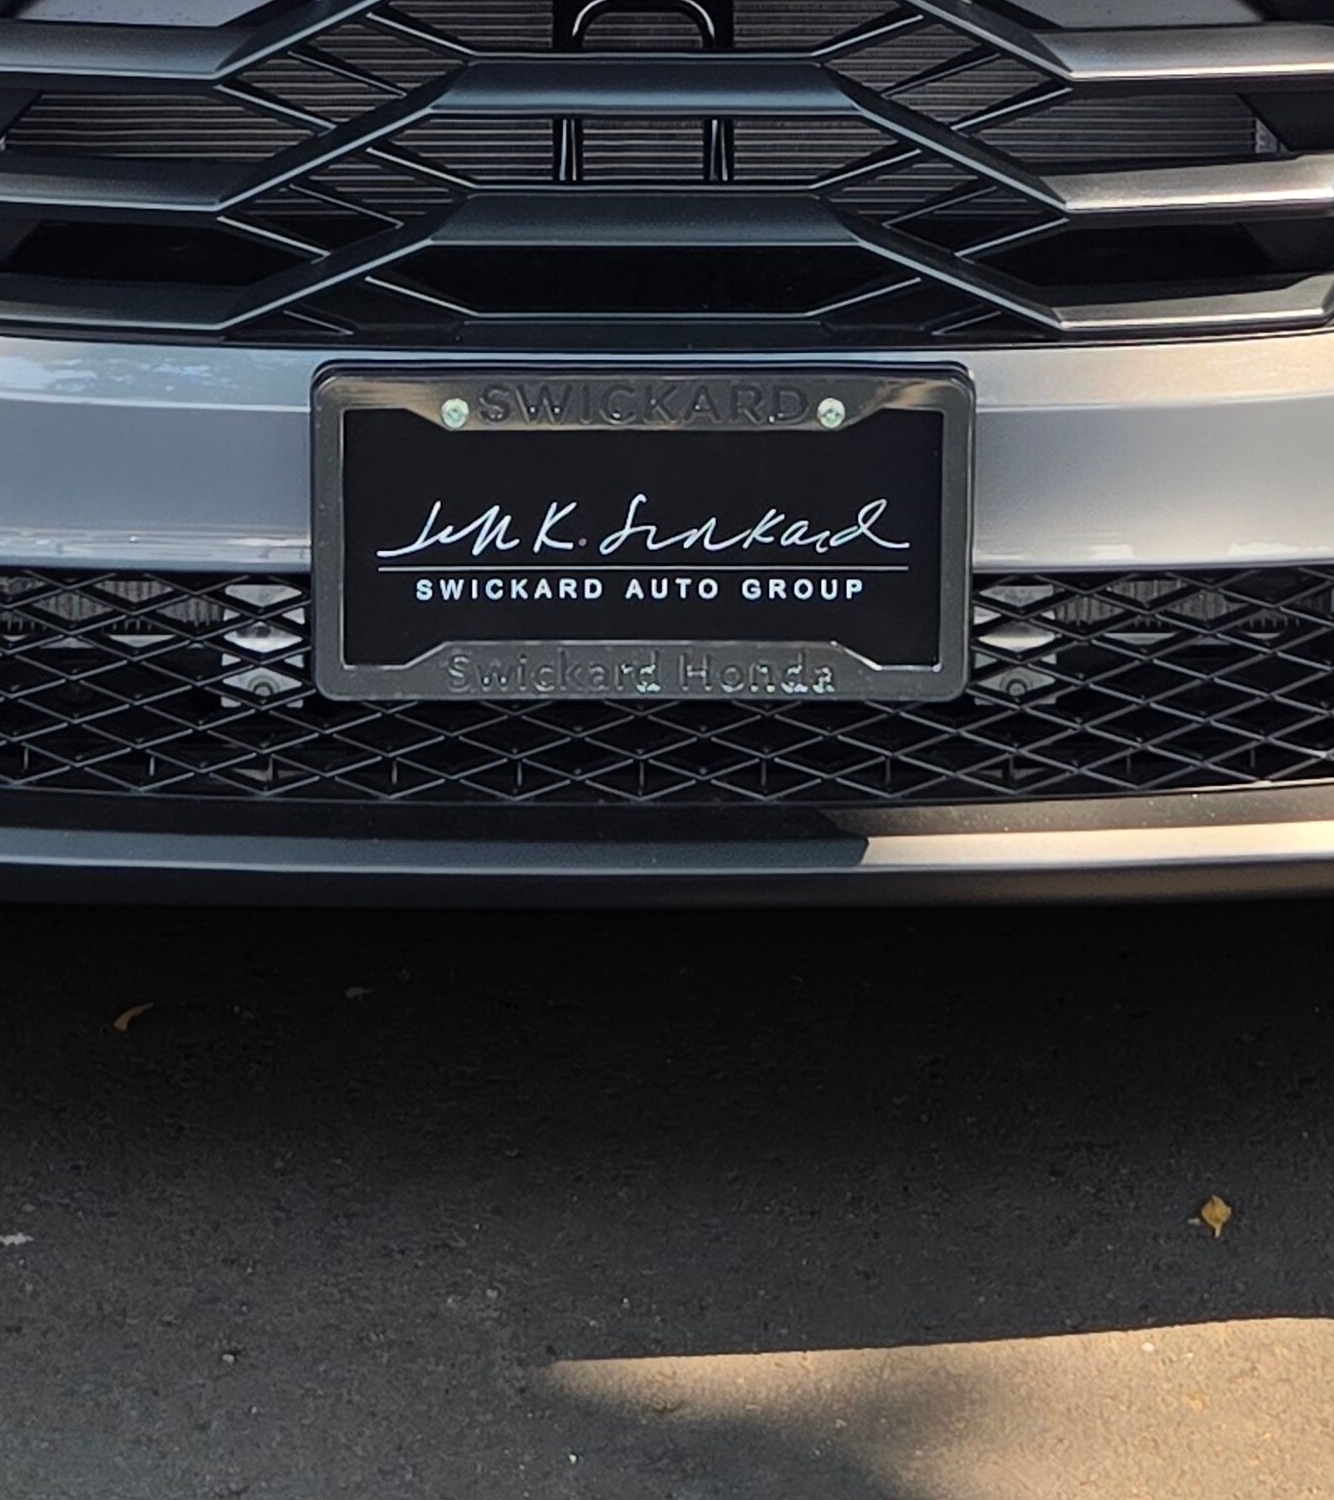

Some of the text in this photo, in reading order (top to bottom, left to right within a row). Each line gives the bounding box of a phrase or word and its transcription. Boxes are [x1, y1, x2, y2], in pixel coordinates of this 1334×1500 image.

[477, 383, 810, 426] SWICKARD
[415, 578, 864, 600] SWICKARD AUTO GROUP
[446, 650, 836, 694] Swickard Honda
